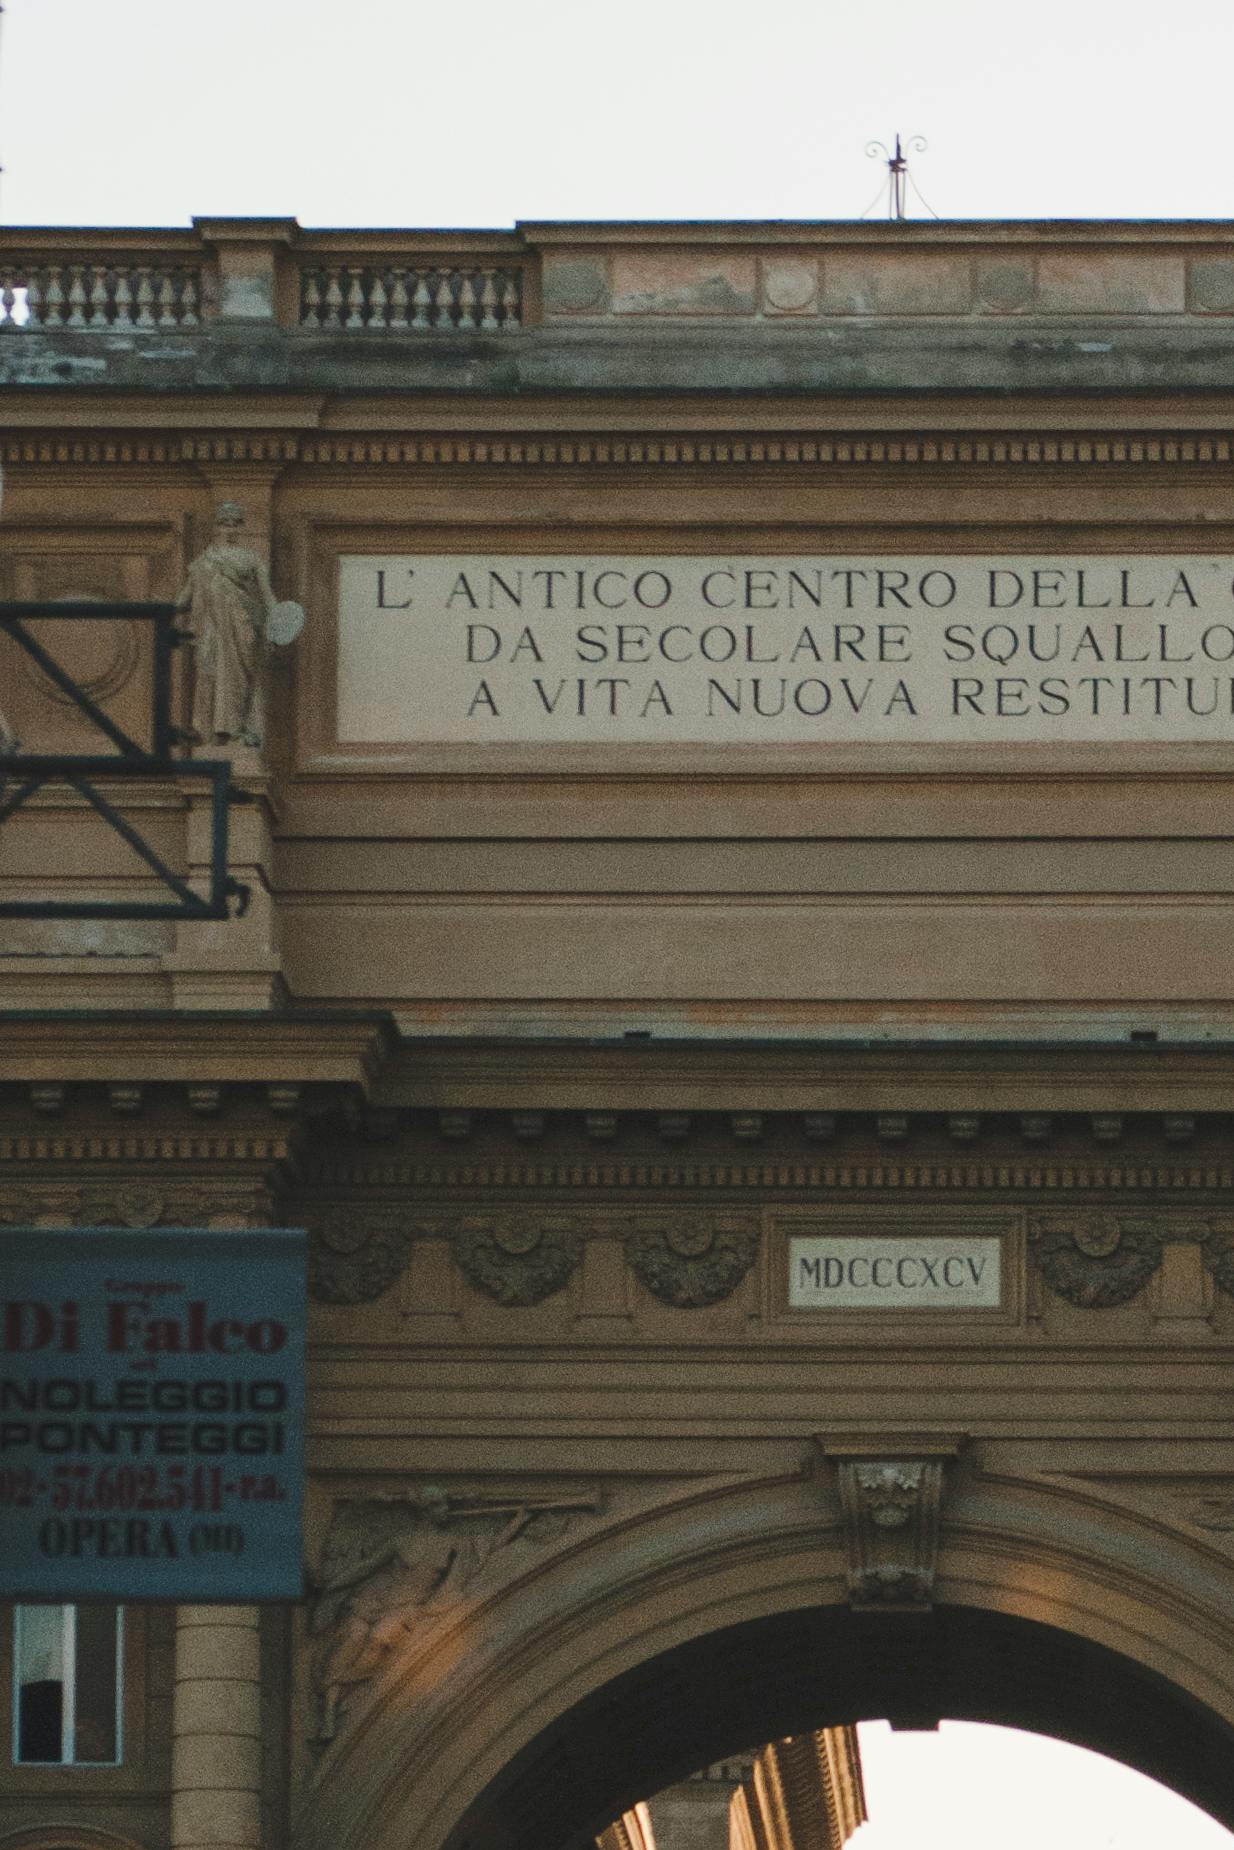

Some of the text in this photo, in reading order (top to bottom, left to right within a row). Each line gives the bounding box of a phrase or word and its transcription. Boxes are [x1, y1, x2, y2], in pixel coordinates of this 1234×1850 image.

[700, 569, 957, 610] CENTRO
[988, 569, 1200, 609] DELLA
[466, 624, 545, 664] DA
[576, 624, 912, 664] SECOLARE
[467, 679, 501, 717] A
[532, 678, 674, 718] VITA
[706, 677, 919, 718] NUOVA
[801, 1257, 986, 1288] MDCCCXCV
[3, 1300, 288, 1354] Di Falco
[1, 1379, 288, 1412] NOLEGGIO
[38, 1518, 179, 1559] OPERA
